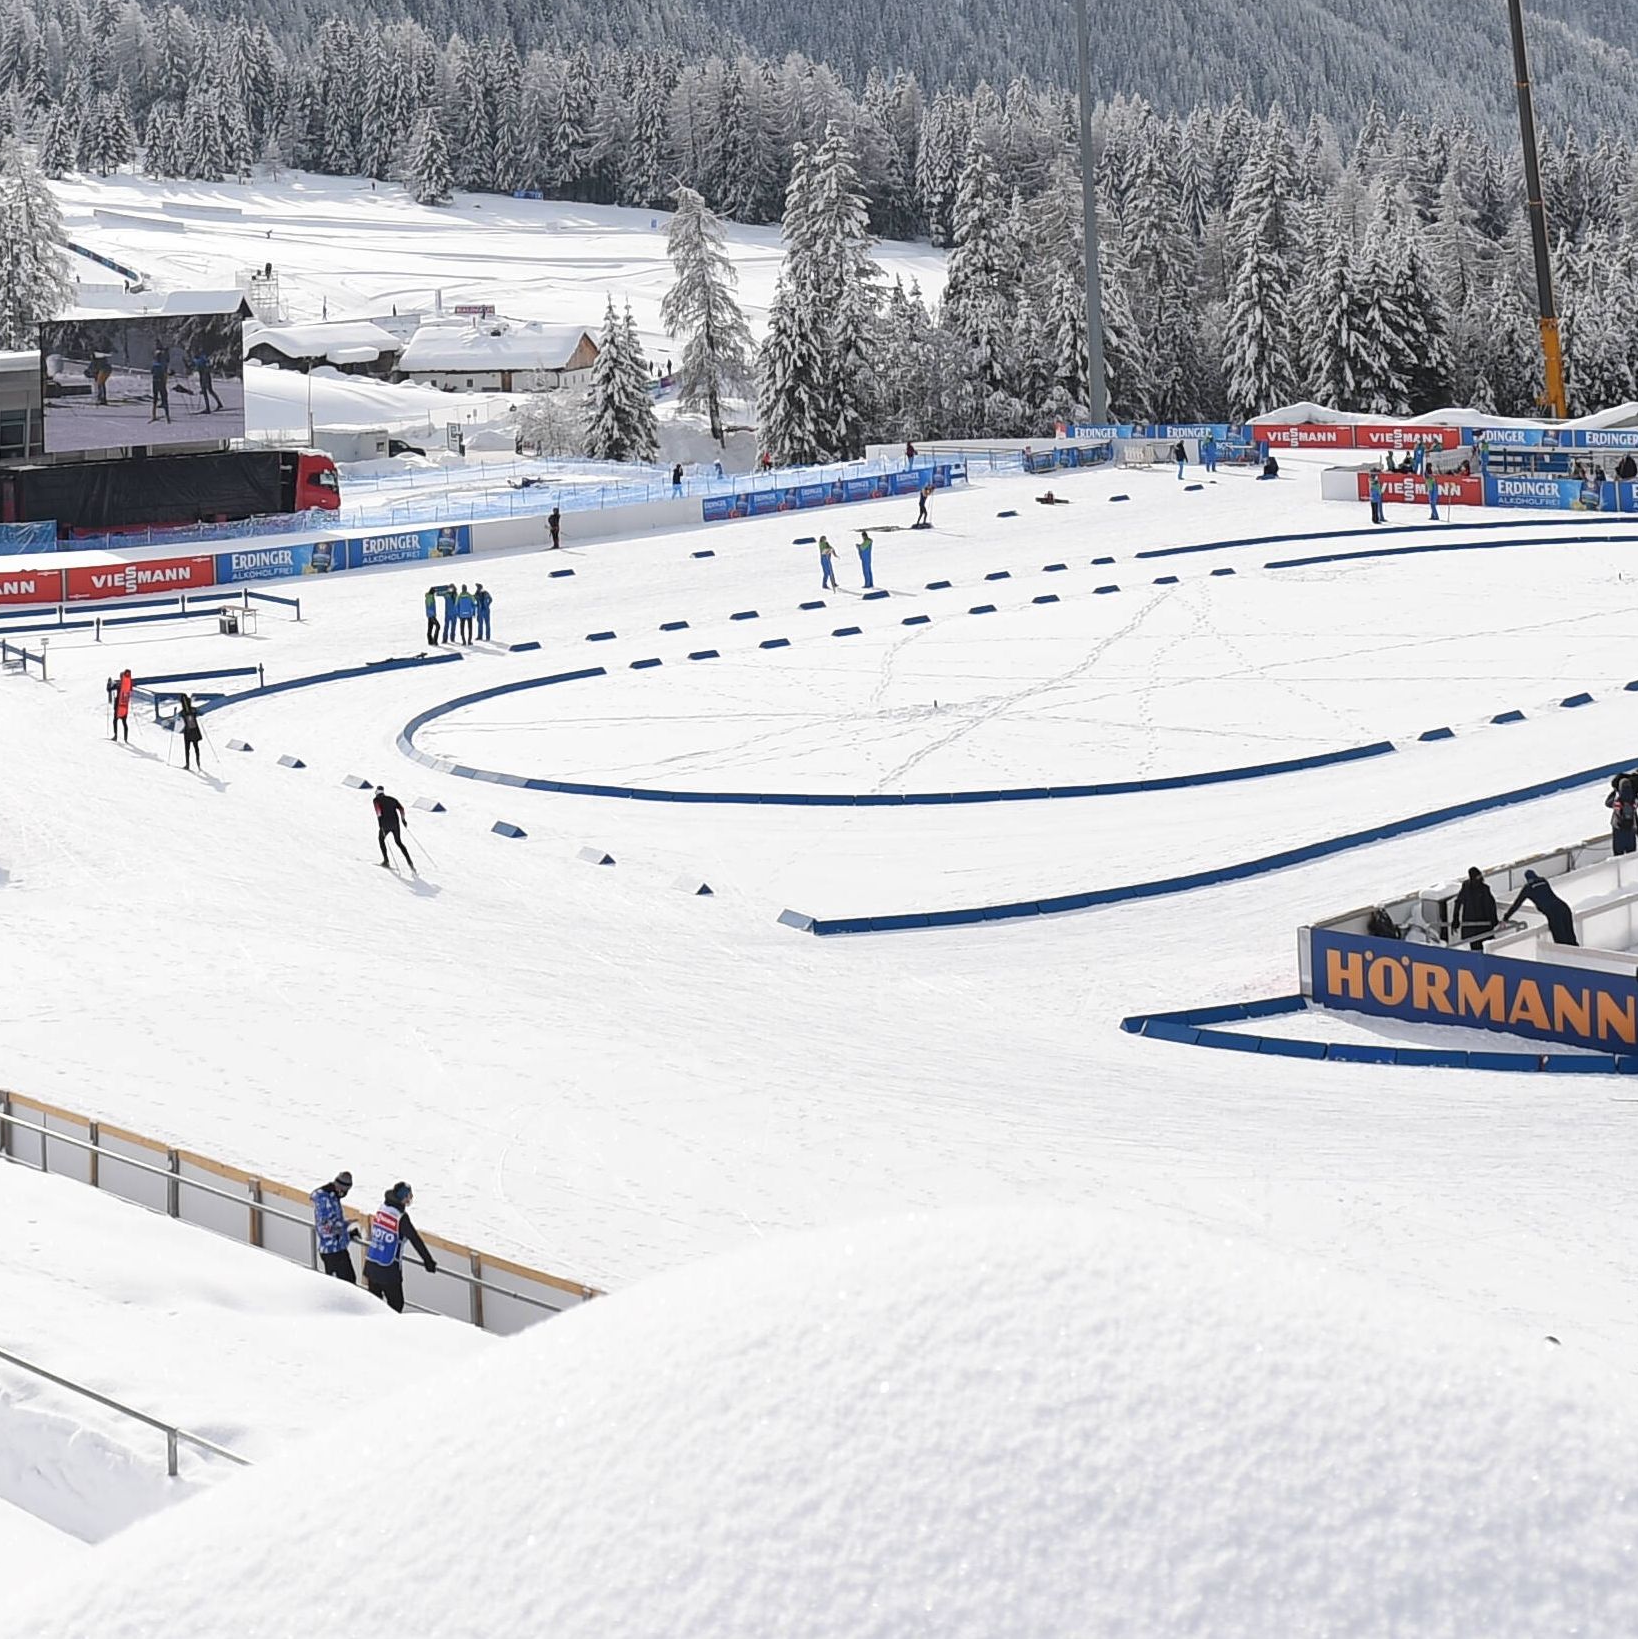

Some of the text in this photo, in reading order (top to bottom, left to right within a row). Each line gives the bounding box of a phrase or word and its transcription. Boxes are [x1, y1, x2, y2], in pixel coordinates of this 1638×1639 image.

[1267, 427, 1337, 447] VIESSMANN
[1497, 481, 1561, 498] ERDINGER
[362, 534, 422, 554] ERDINGER
[231, 550, 294, 570] ERDINGER
[91, 565, 192, 594] VIESSMANN
[1326, 948, 1637, 1044] HÖRMANN
